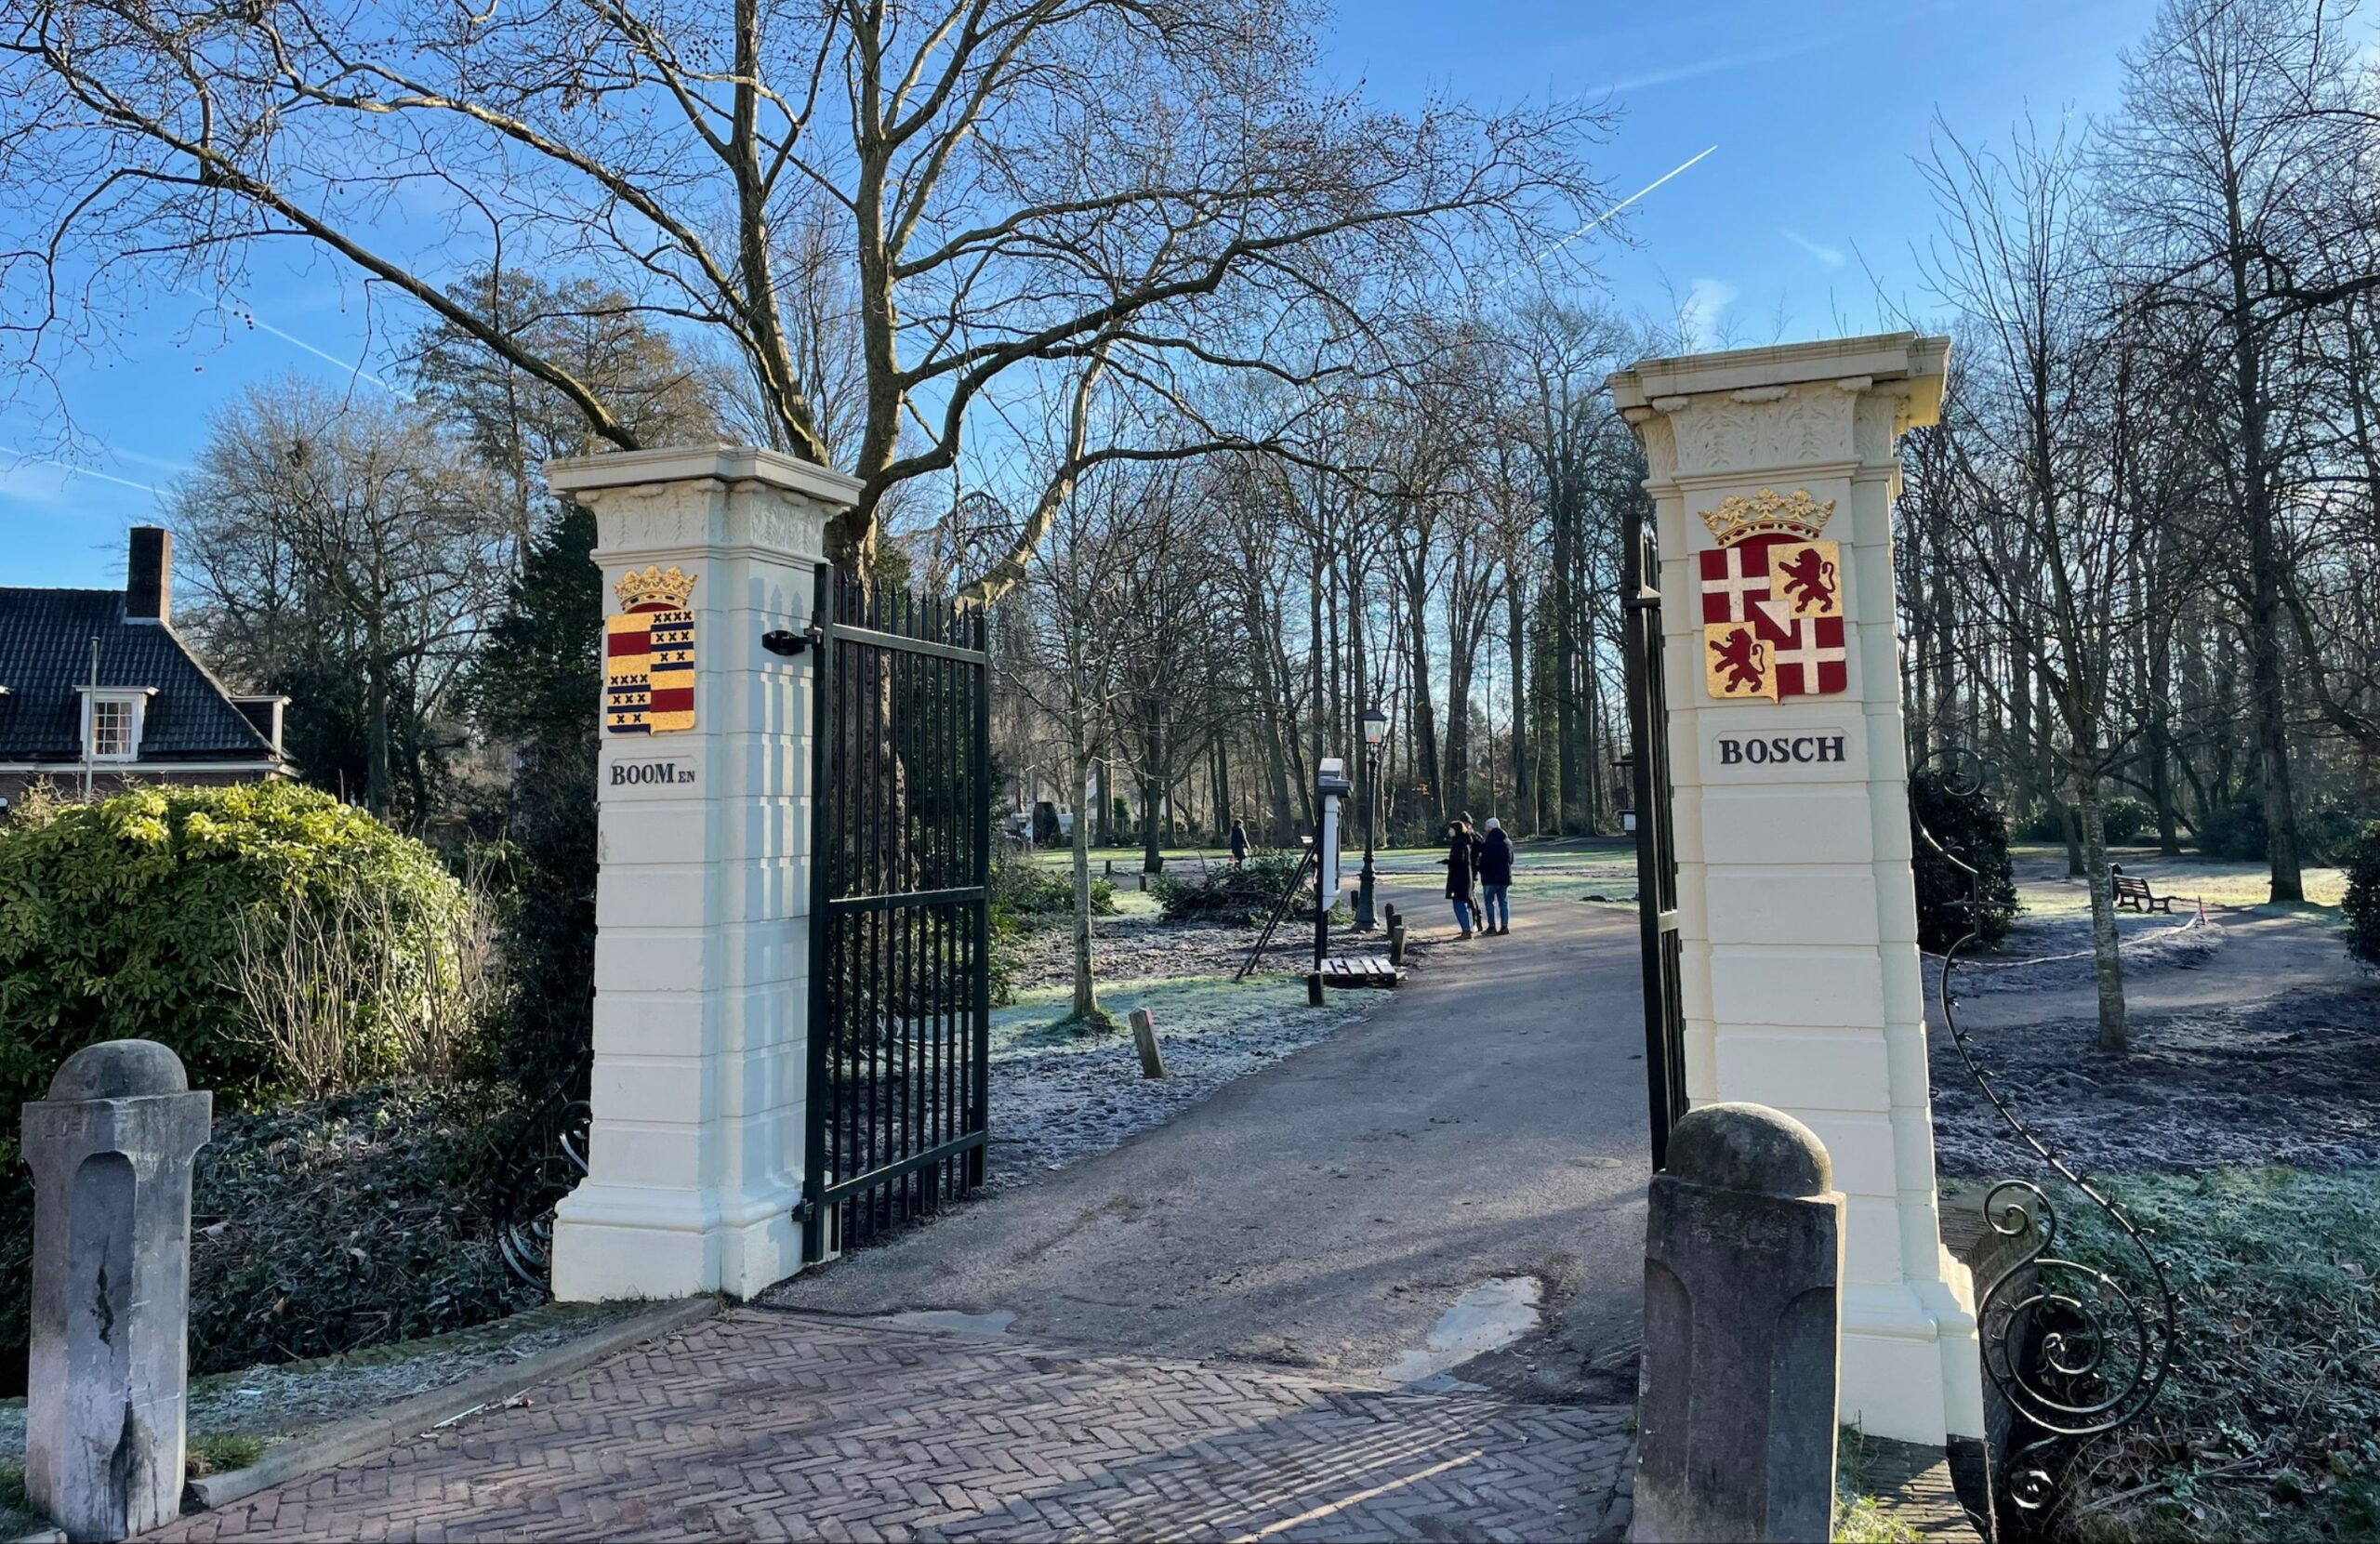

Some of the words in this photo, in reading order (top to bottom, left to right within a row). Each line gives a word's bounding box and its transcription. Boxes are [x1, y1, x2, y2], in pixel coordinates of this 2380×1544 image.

[1719, 736, 1845, 765] BOSCH
[610, 763, 676, 785] BOOM
[678, 771, 695, 783] EN
